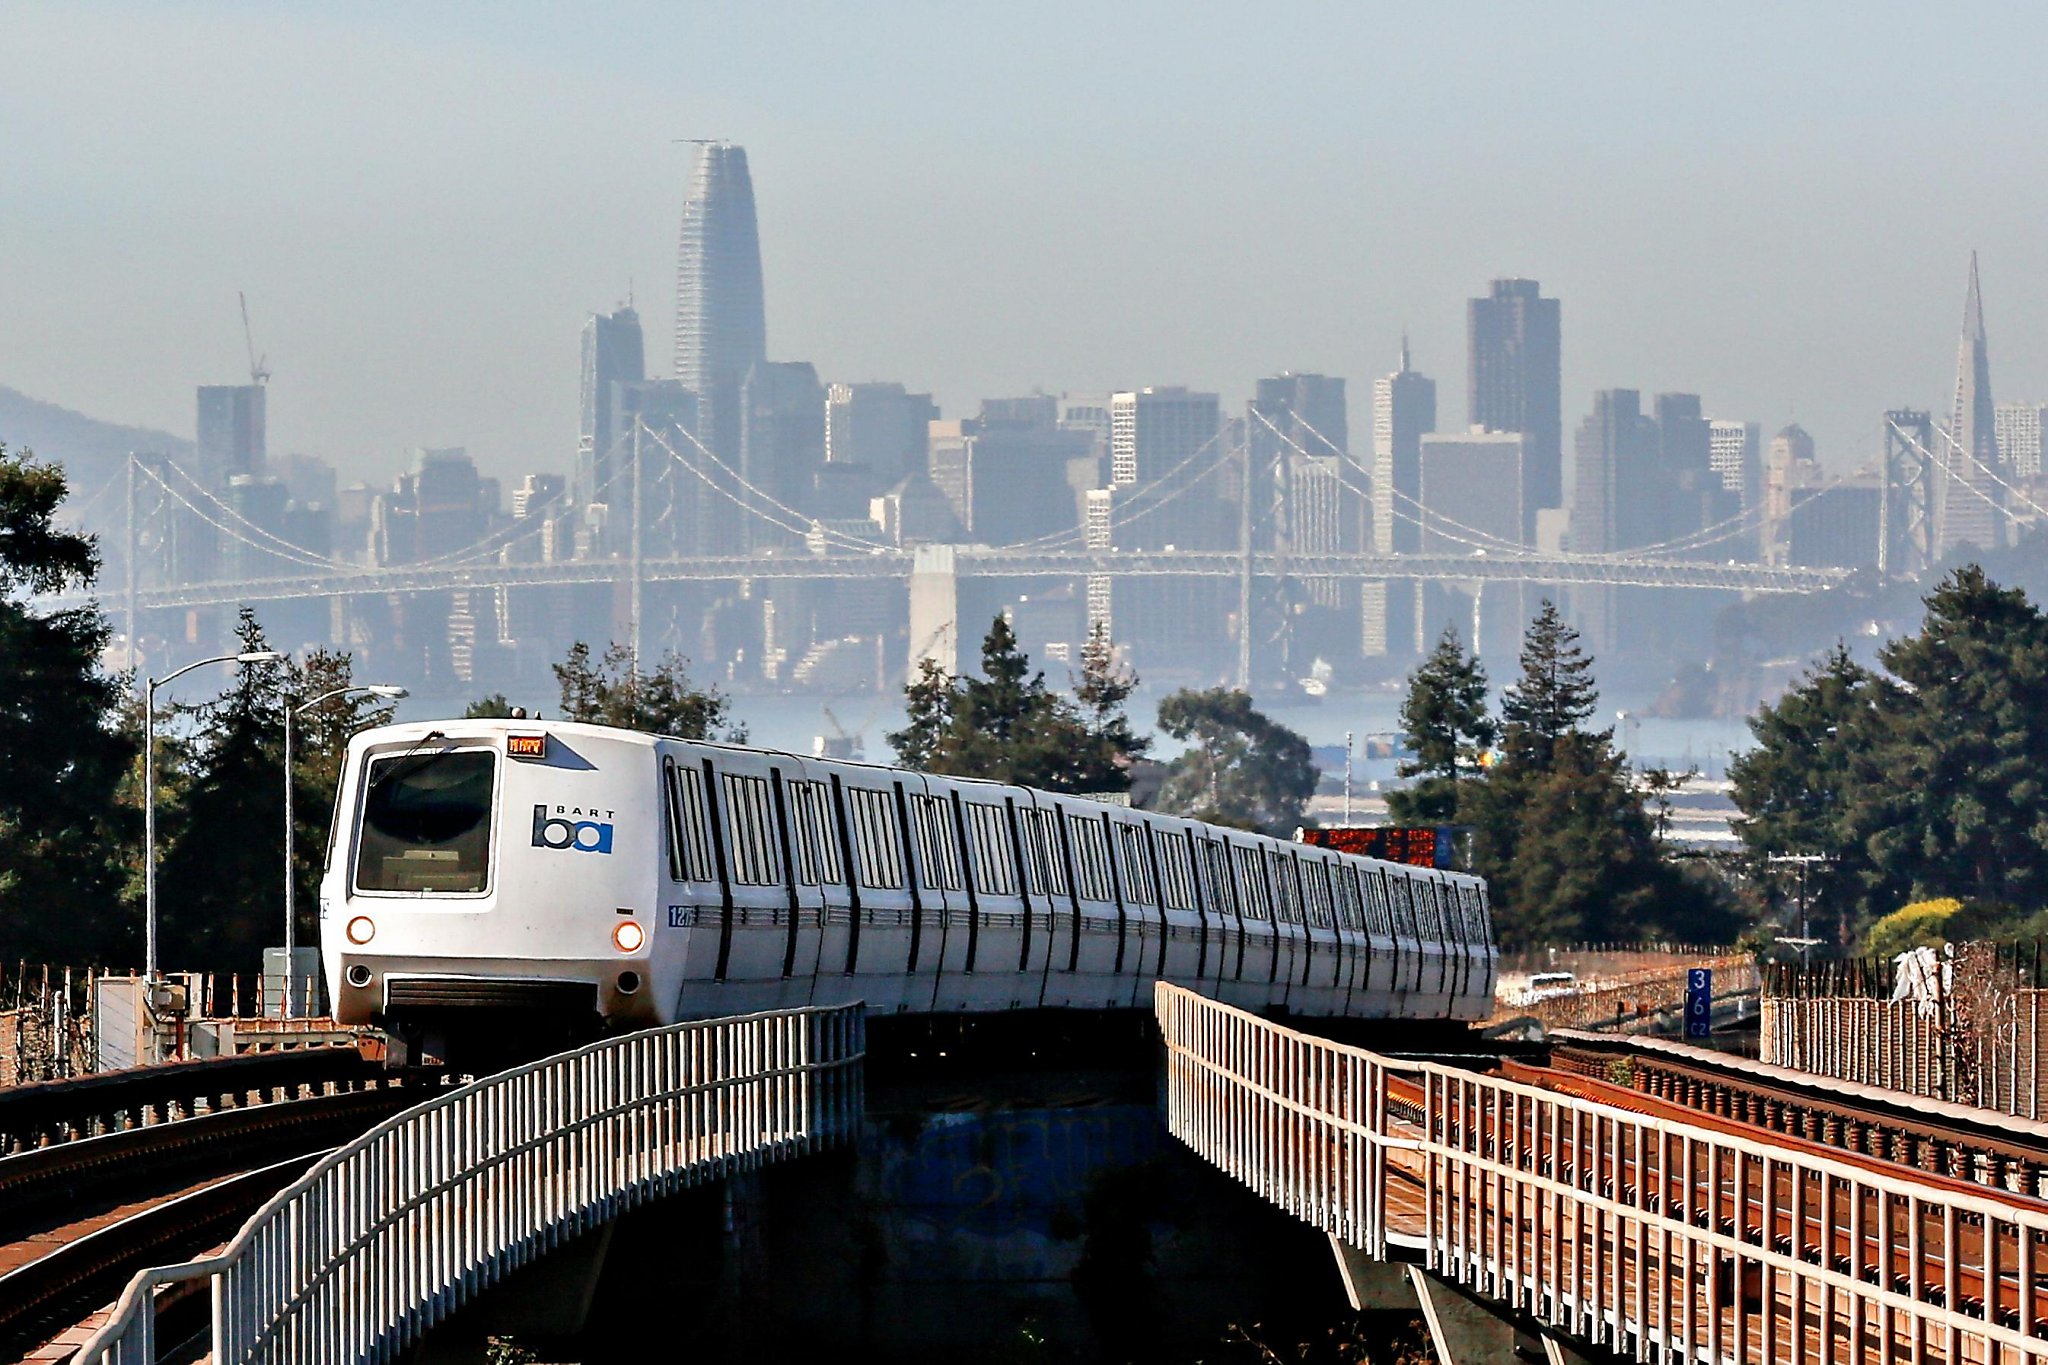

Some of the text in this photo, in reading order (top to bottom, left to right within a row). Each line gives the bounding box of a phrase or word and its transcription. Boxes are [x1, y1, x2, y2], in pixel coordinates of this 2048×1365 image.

[555, 805, 615, 819] BART
[1694, 970, 1705, 989] 3
[1694, 997, 1705, 1015] 6
